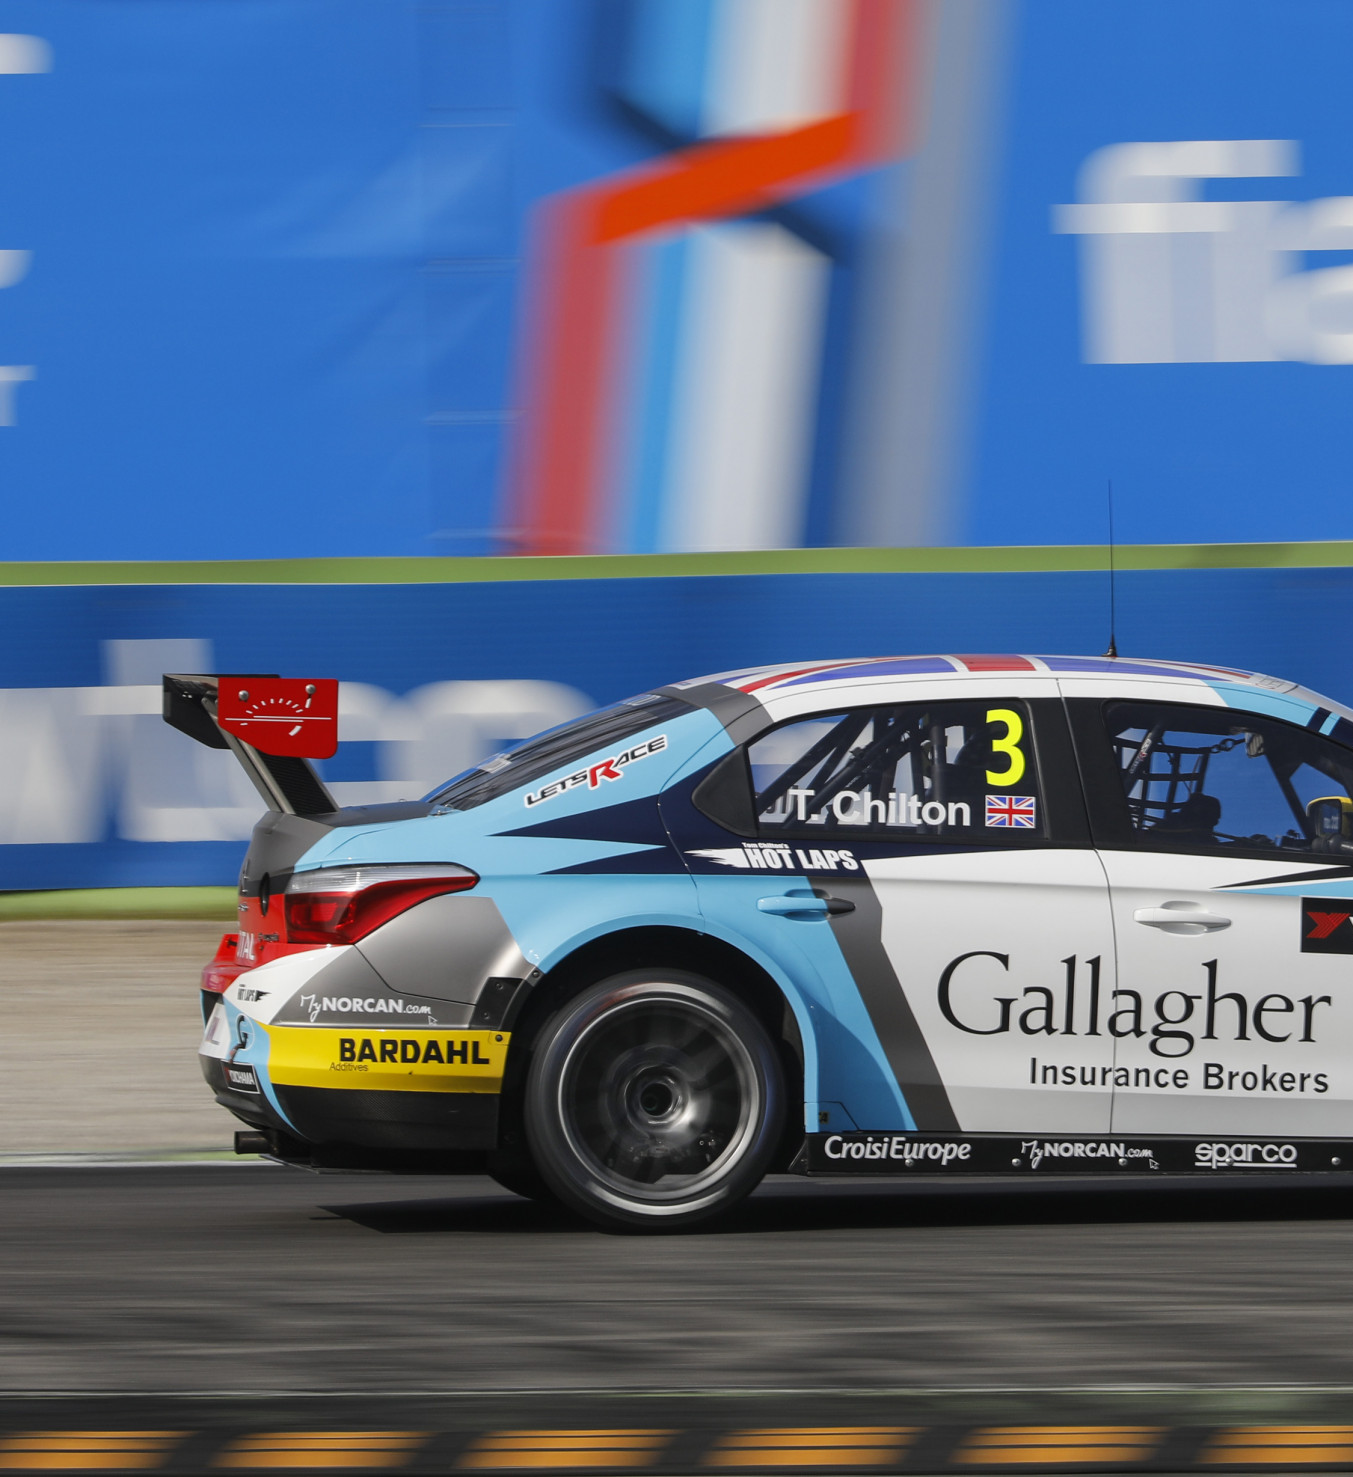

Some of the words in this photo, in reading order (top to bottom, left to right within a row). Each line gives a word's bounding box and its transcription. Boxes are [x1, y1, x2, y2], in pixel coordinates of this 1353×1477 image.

[985, 708, 1026, 787] 3
[526, 736, 667, 806] LETSRACE
[788, 789, 819, 821] T.
[832, 790, 971, 827] Chilton
[743, 848, 796, 869] HOT
[794, 849, 860, 871] LAPS
[936, 950, 1333, 1059] Gallagher
[328, 1062, 370, 1072] Additives
[339, 1037, 491, 1065] BARDAHL
[1029, 1057, 1189, 1090] Insurance
[1202, 1062, 1330, 1094] Brokers
[824, 1135, 972, 1166] CroisiEurope
[1194, 1142, 1298, 1170] sparco
